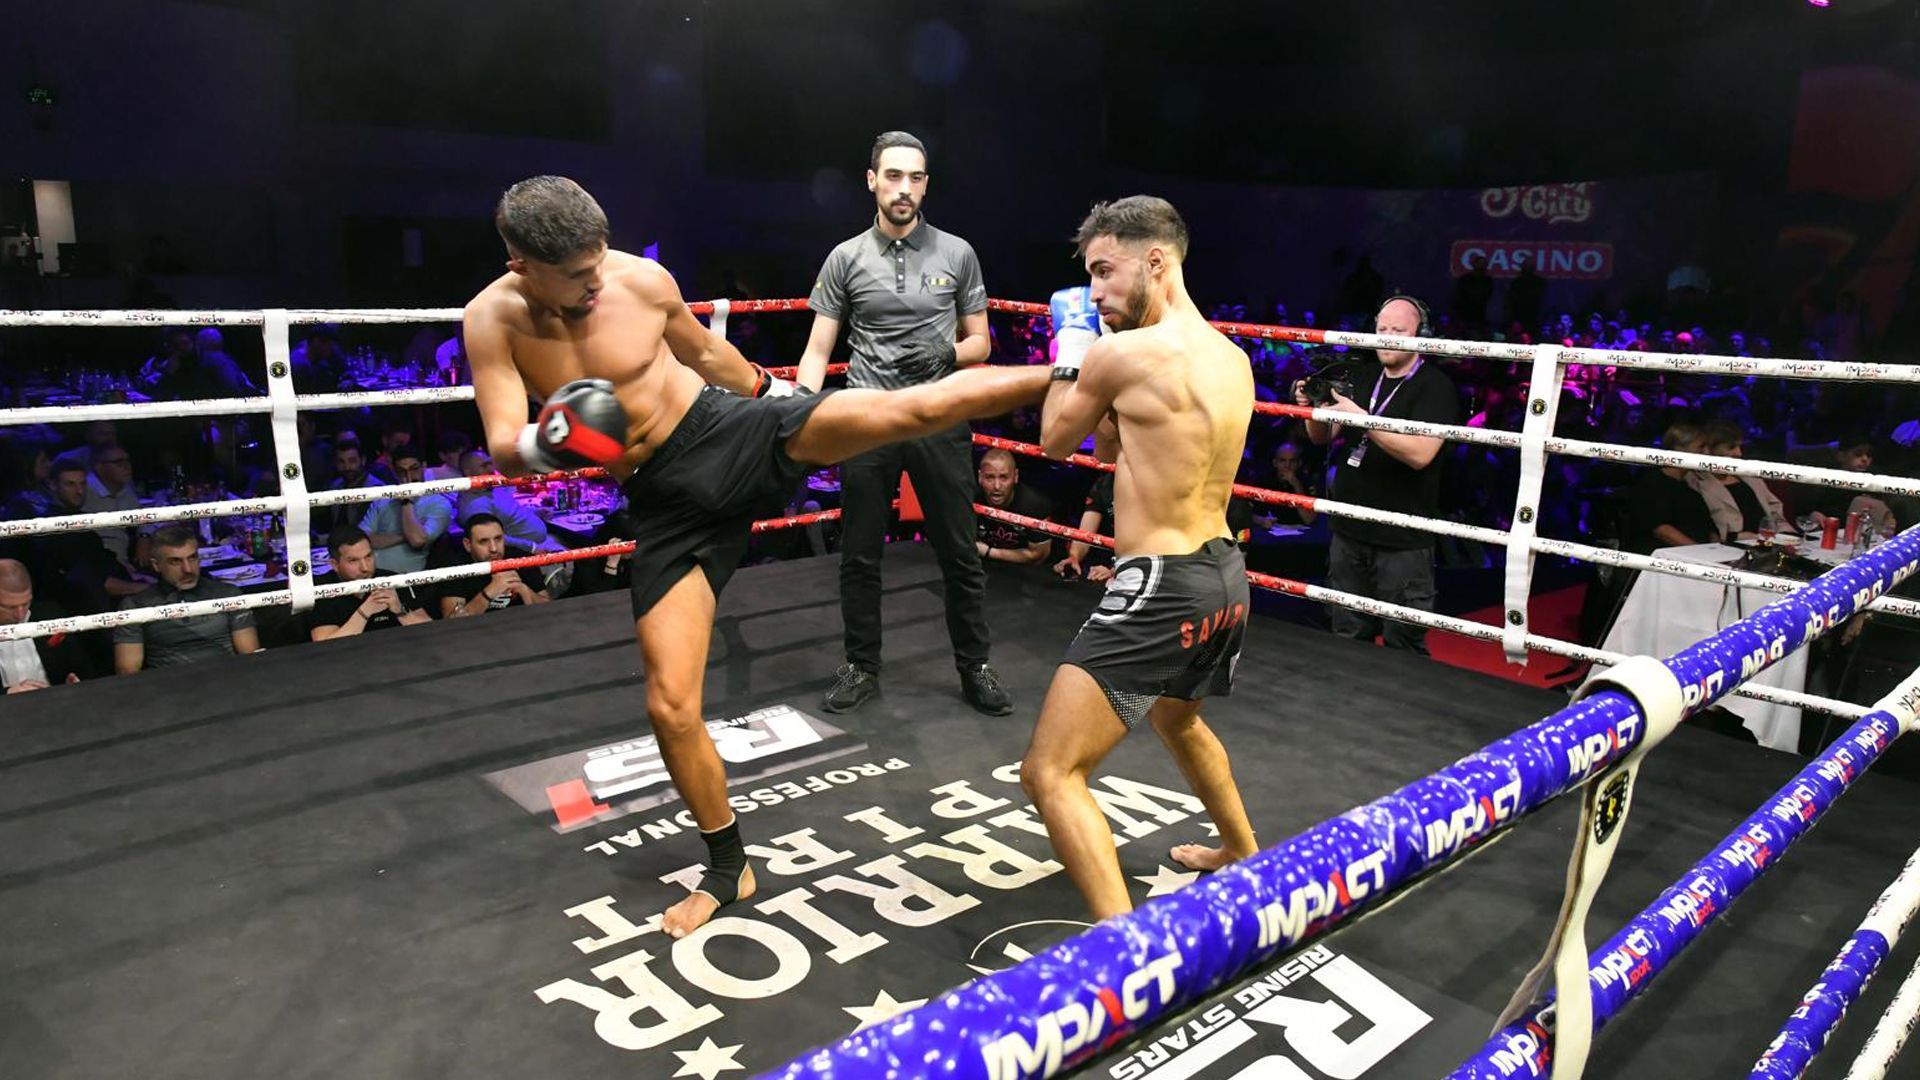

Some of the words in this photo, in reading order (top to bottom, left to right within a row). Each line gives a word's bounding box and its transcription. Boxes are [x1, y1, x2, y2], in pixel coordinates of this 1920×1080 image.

[1460, 248, 1603, 272] CASINO
[1557, 351, 1586, 360] MPACT
[1782, 362, 1825, 374] IMPACT
[1846, 365, 1890, 377] IMPACT
[1646, 454, 1684, 466] IMPACT
[1699, 461, 1738, 473] IMPACT
[1759, 468, 1800, 480] IMPACT
[1820, 477, 1864, 489] IMPACT
[425, 485, 455, 494] IMPACT
[1884, 485, 1920, 496] IMPAC
[334, 494, 367, 503] IMPACT
[181, 508, 217, 518] IMPACT
[232, 503, 267, 513] IMPACT
[119, 513, 158, 522] IMPACT
[1703, 571, 1741, 584] IMPACT
[360, 581, 392, 591] IMPACT
[1760, 581, 1796, 592] MPACT
[1884, 603, 1920, 615] MPACT
[1567, 713, 1639, 779] IMPACT
[584, 757, 911, 856] PROFESSONAL
[1424, 779, 1521, 859] IMPACT
[1257, 849, 1387, 948] IMPACT
[1659, 875, 1717, 928] IMPACT
[1589, 928, 1653, 990] IMPACT
[1233, 943, 1336, 1010] RISING
[981, 950, 1183, 1080] IMPACT
[1108, 1003, 1237, 1080] STARS
[1489, 1021, 1550, 1077] IMPA
